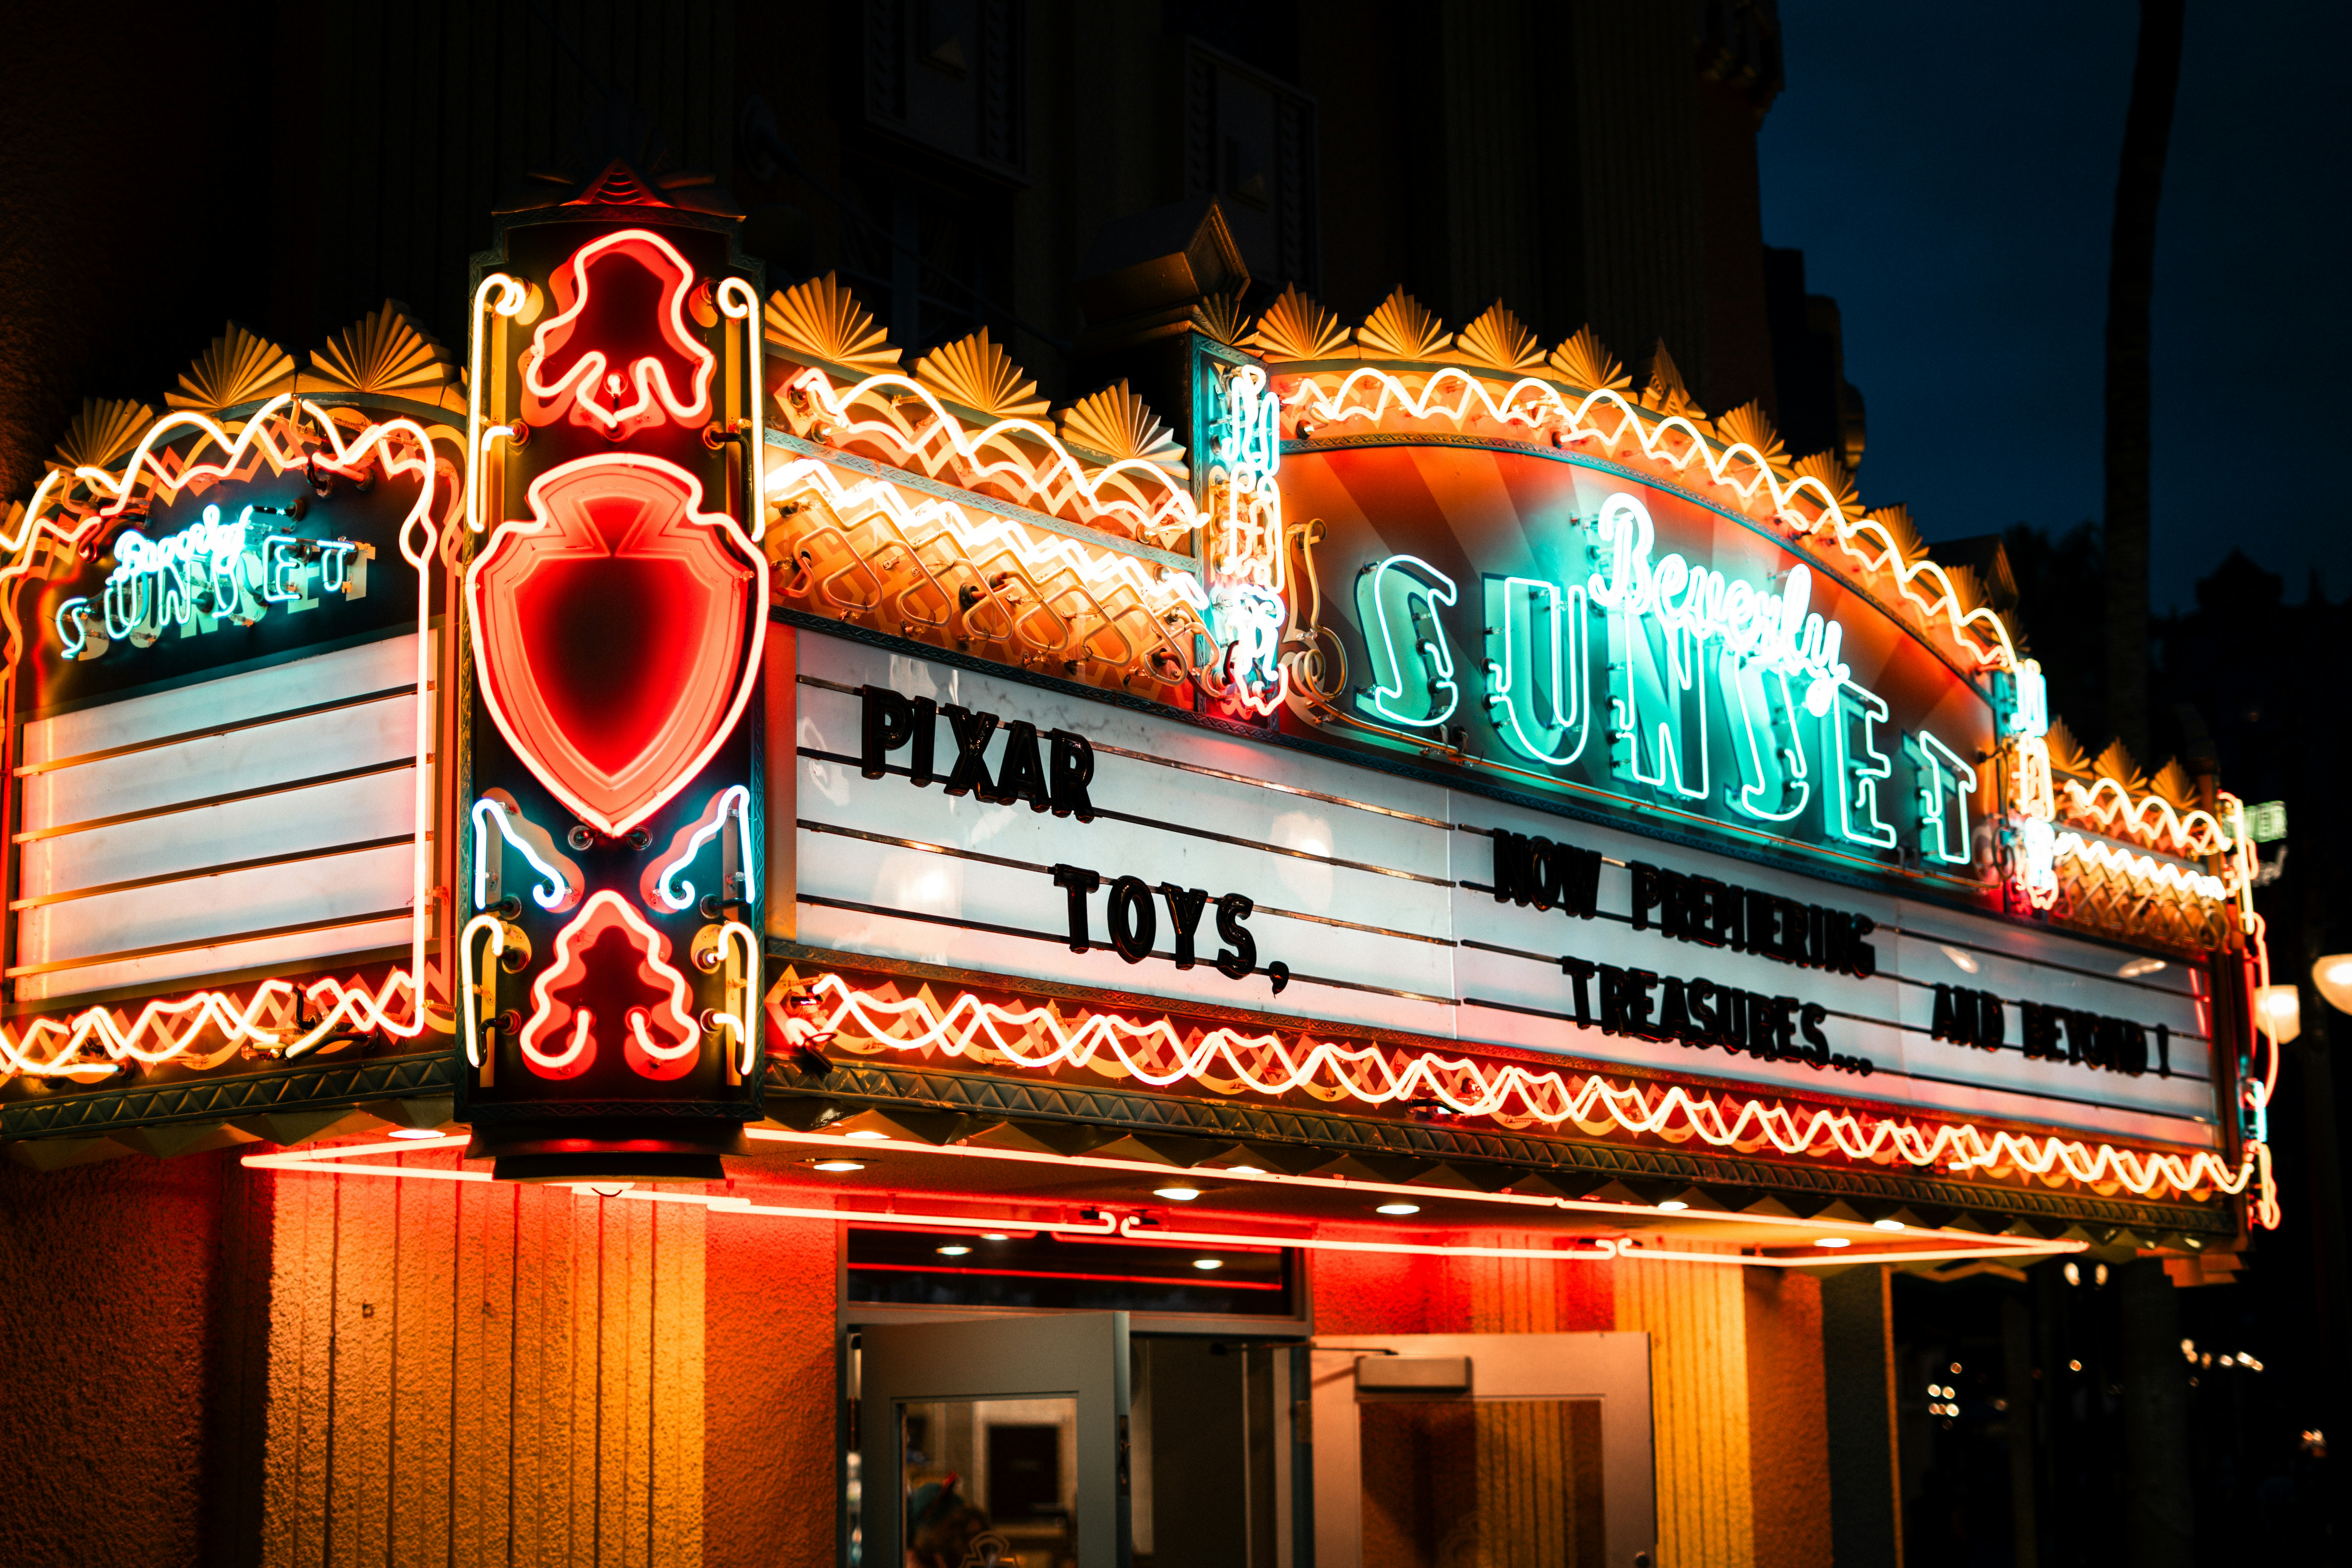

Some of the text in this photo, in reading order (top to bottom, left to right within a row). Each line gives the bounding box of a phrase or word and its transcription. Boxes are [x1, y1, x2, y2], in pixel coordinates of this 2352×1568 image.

[56, 535, 376, 662] SUNSET
[1588, 492, 1850, 717] Beverly
[861, 684, 1095, 824] PIXAR
[1353, 554, 1977, 865] SUNSET
[1053, 863, 1289, 996] TOYS,
[1493, 827, 1876, 979] NOW PREMIERING
[1931, 982, 2005, 1052] AND
